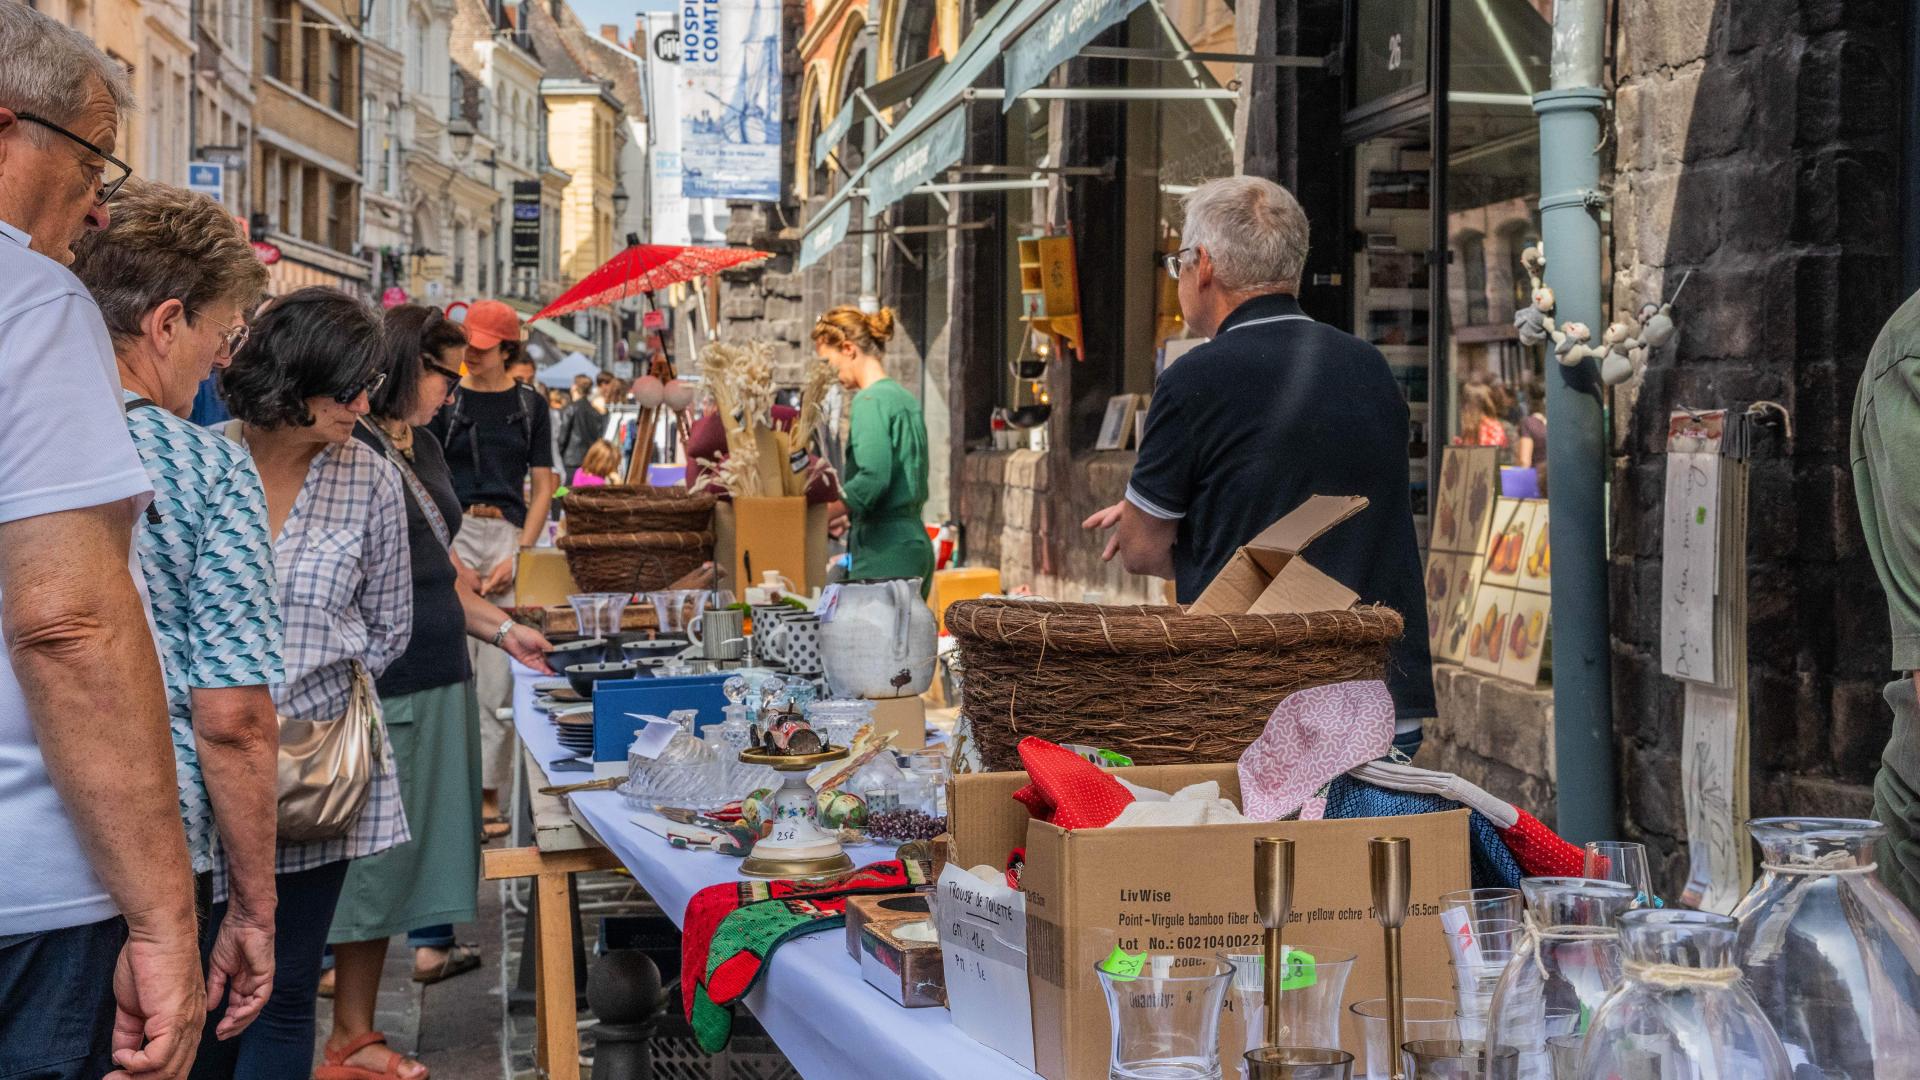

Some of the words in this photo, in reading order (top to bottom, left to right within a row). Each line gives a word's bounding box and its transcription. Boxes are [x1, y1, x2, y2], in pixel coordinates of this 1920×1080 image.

[1119, 889, 1172, 902] LivWise
[1188, 913, 1224, 926] bamboo
[1228, 913, 1249, 925] fiber
[1307, 907, 1335, 924] yellow
[1338, 908, 1363, 921] ochre
[1118, 937, 1139, 950] Lot
